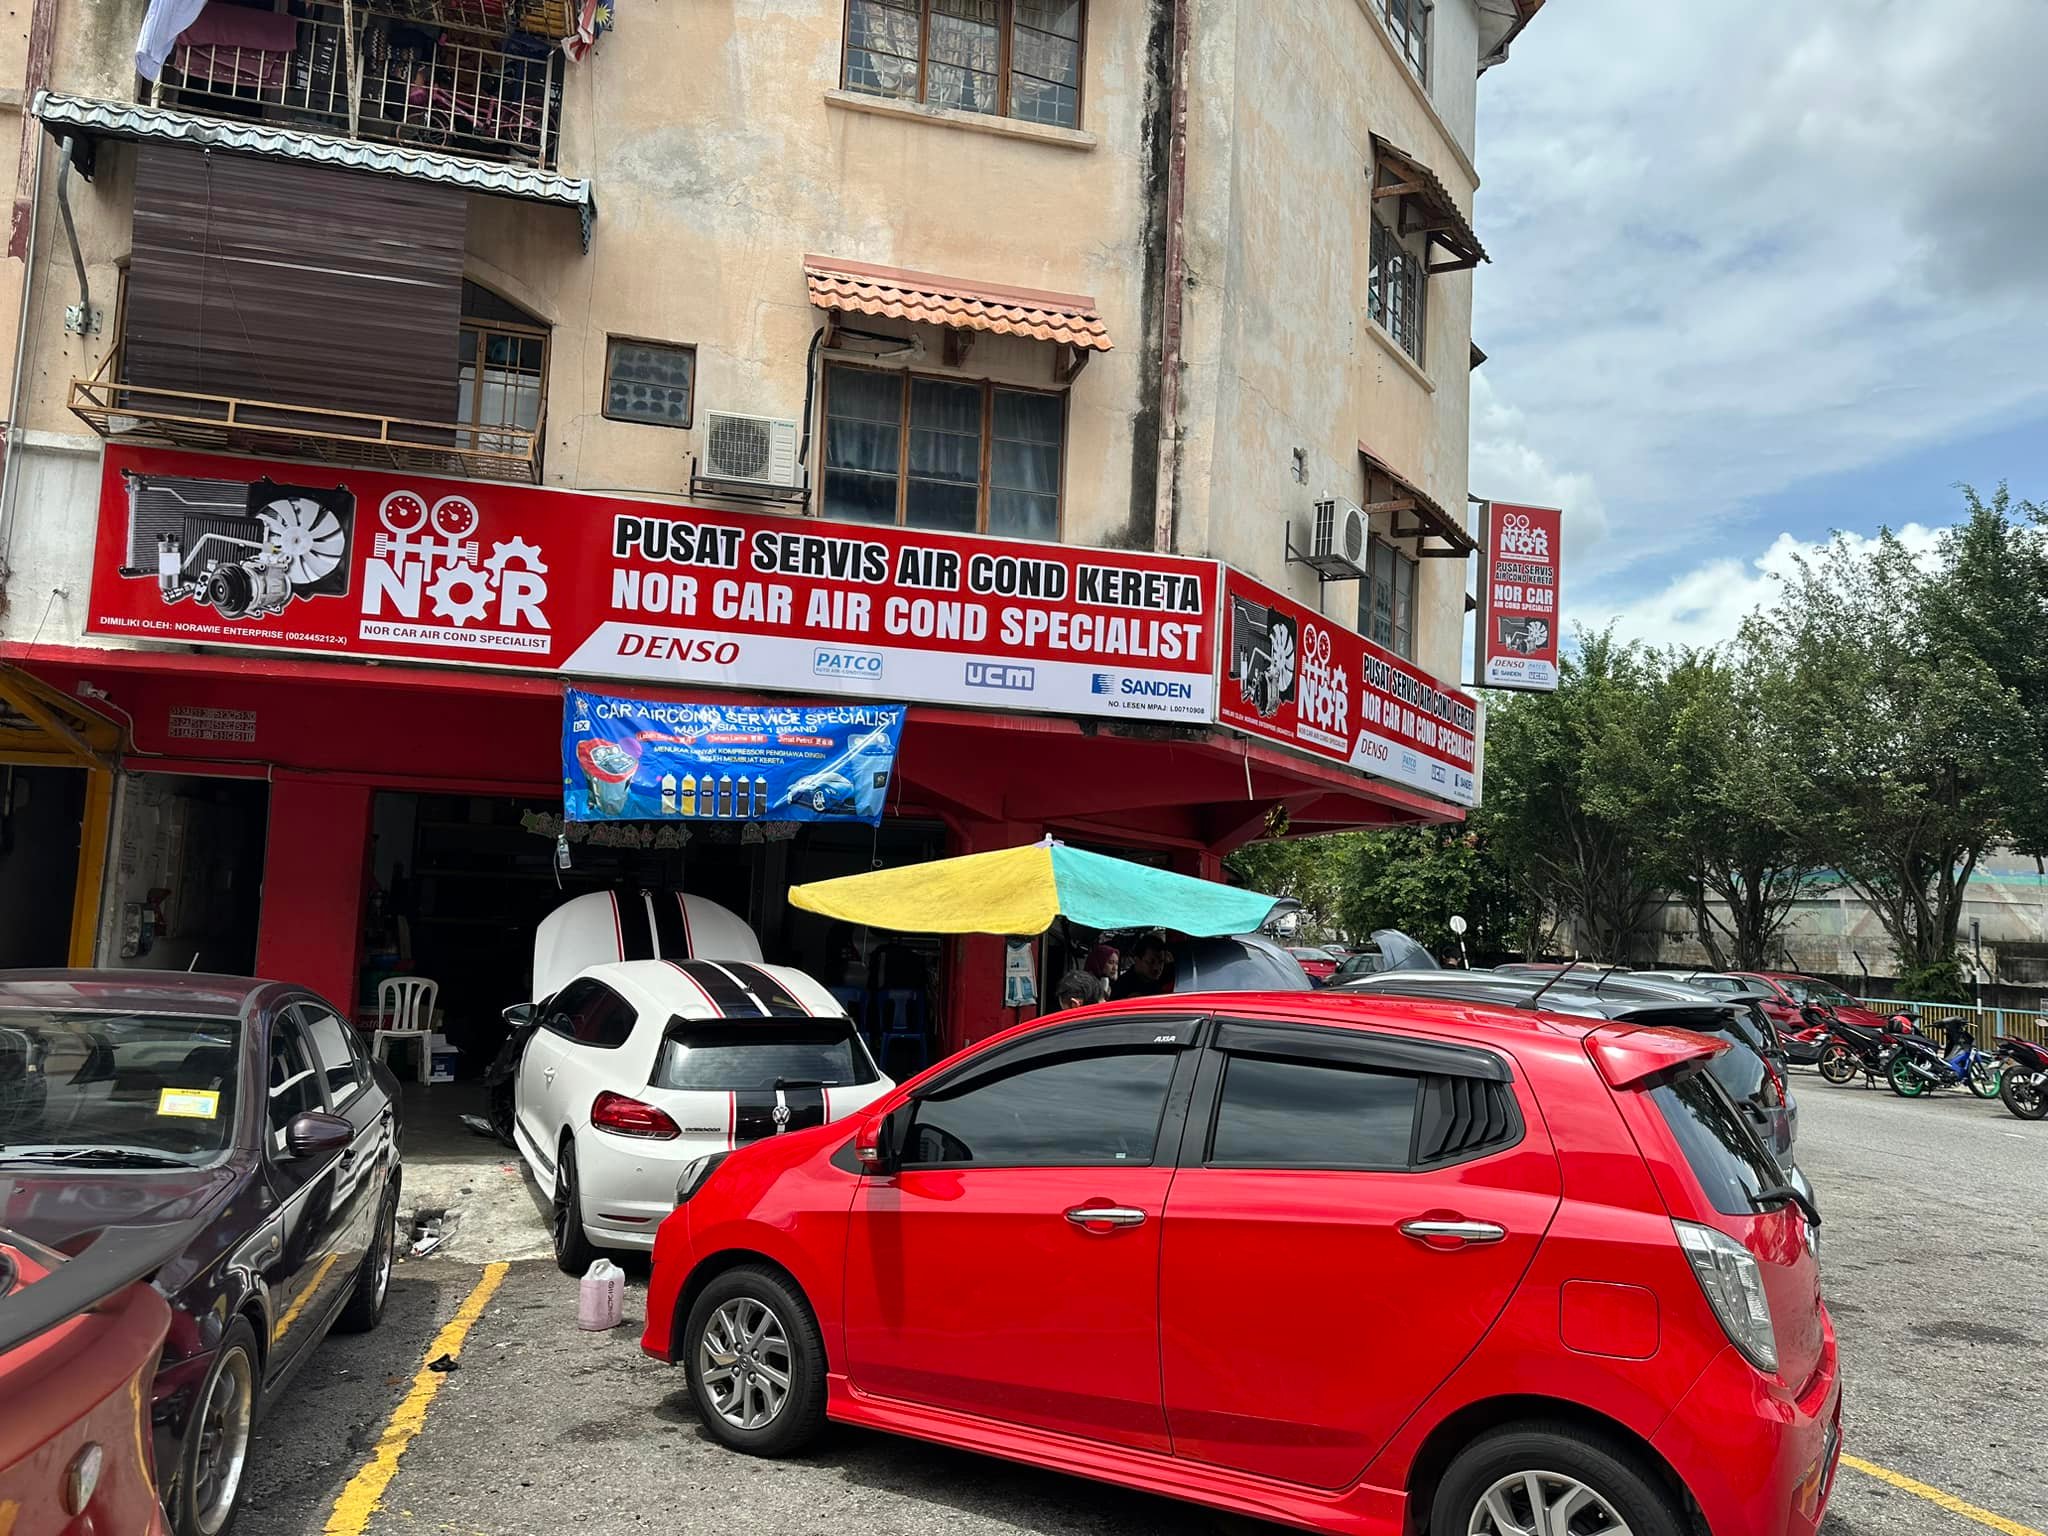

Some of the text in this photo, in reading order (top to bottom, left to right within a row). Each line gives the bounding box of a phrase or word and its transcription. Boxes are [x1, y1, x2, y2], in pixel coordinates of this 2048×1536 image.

[615, 516, 1201, 613] PUSAT SERVIS AIR COND KERETA
[1496, 562, 1553, 577] PUSAT SERVIS
[1495, 572, 1508, 580] AIR
[1508, 573, 1527, 582] COND
[361, 557, 551, 629] NOR
[1494, 583, 1554, 605] NOR CAR
[611, 568, 1202, 661] NOR CAR AIR COND SPECIALIST
[100, 616, 347, 646] DIMILIKI OLEH: NORAWIE ENTERPRISE (002445212-X)
[364, 625, 547, 649] NOR CAR AIR COND SPECIALIST
[616, 632, 740, 665] DENSO
[816, 653, 881, 671] PATCO
[1494, 659, 1525, 669] DENSO
[1120, 678, 1192, 699] SANDEN
[1363, 653, 1391, 693] PUSAT
[1391, 667, 1419, 707] SERVIS
[1419, 683, 1433, 713] AIR
[1433, 690, 1452, 722] COND
[596, 703, 900, 727] CAR AIRCOND SERVICE SPECIALIST
[1122, 701, 1146, 710] LESEN
[1298, 674, 1348, 735] NOR
[674, 722, 738, 733] MALAYSIA
[741, 725, 765, 734] TOP
[776, 724, 818, 735] BRAND
[1361, 689, 1475, 763] NOR CAR AIR COND SPECIALIST
[1360, 736, 1389, 761] DENSO
